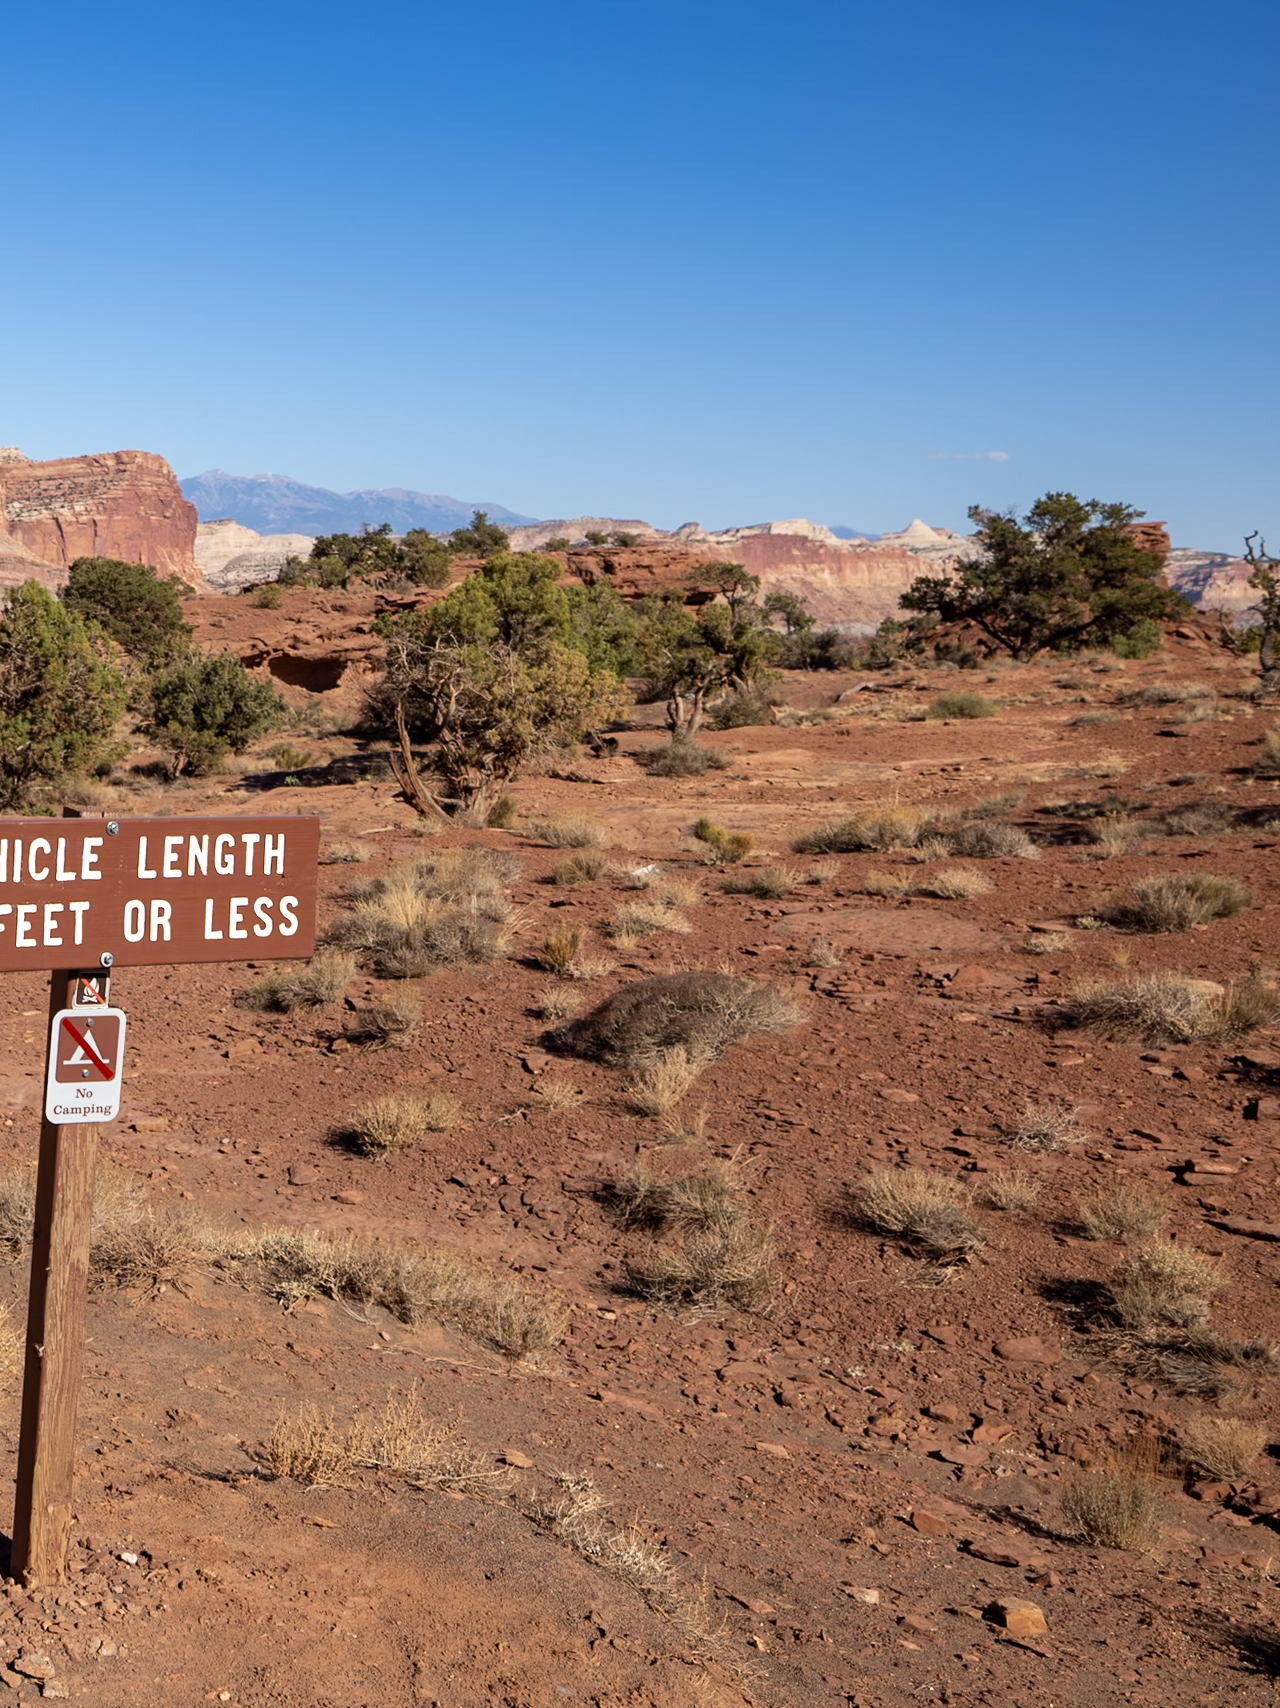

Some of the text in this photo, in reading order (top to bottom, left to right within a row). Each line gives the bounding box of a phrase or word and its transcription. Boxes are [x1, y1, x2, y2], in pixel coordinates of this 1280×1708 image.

[137, 833, 285, 879] LENGTH
[123, 899, 172, 943] OR
[204, 895, 299, 940] LESS
[75, 1088, 93, 1099] No
[53, 1103, 112, 1117] Camping
